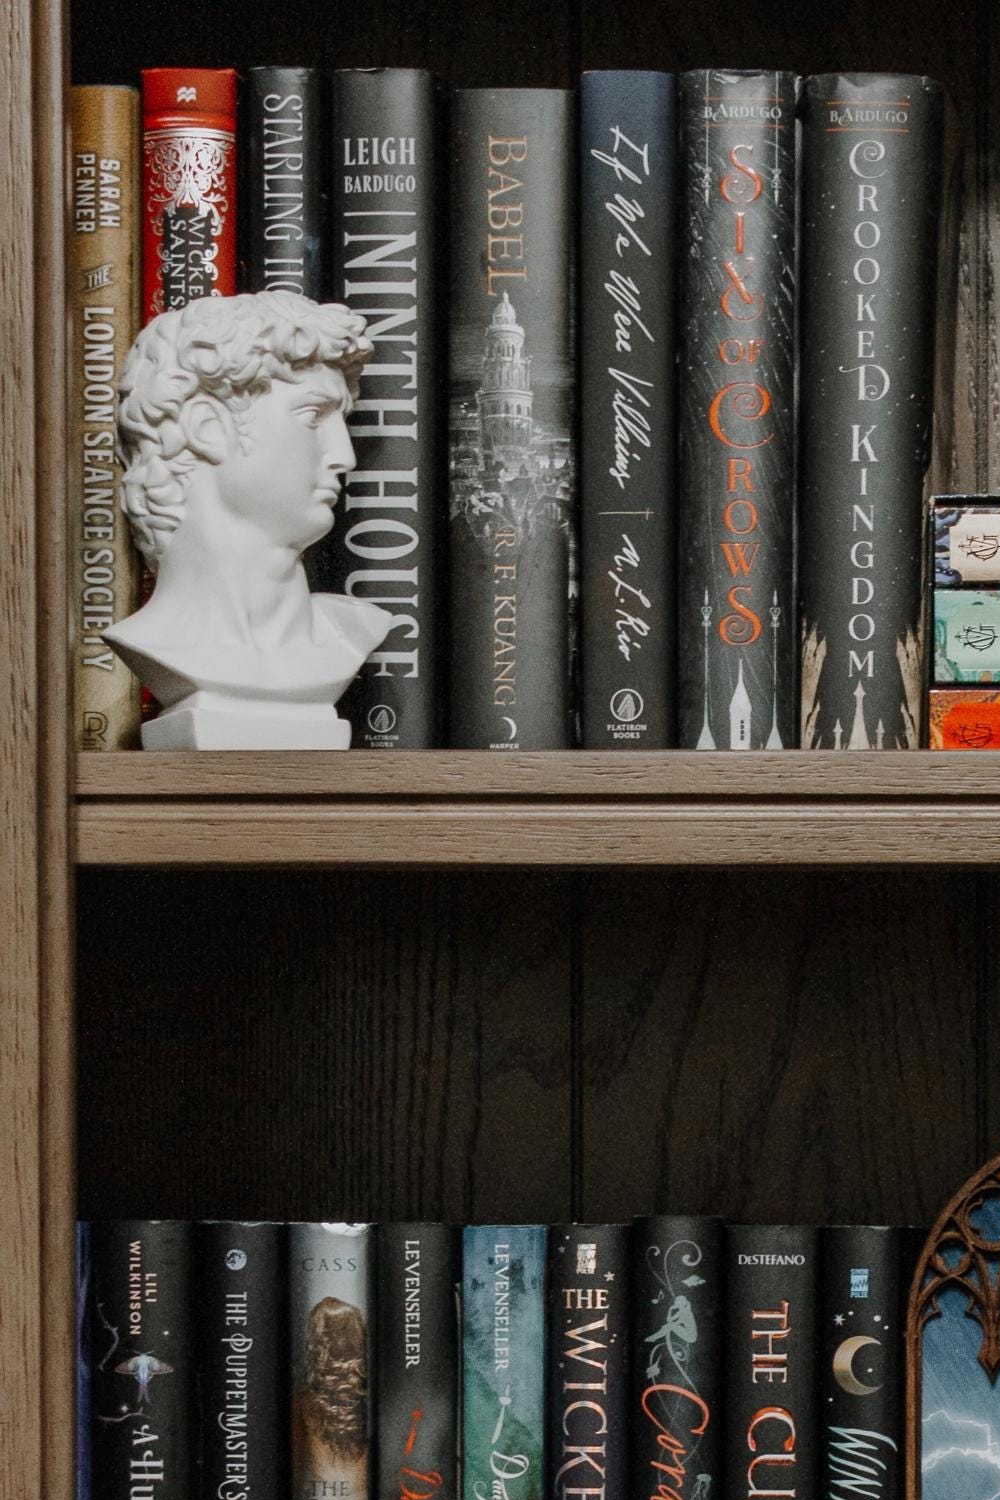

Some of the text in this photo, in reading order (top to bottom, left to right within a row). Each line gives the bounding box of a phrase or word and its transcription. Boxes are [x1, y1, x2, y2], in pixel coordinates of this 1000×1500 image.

[343, 137, 417, 166] LEIGH
[703, 103, 783, 123] BARDUGO
[828, 107, 909, 126] BARDUGO
[75, 153, 96, 233] PENNER
[99, 158, 121, 228] SARAH
[263, 93, 304, 241] STARLING
[343, 175, 417, 194] BARDUGO
[486, 134, 529, 296] BABEL
[168, 220, 185, 308] SAINTS
[600, 193, 656, 490] We Were Villains
[83, 306, 121, 541] LONDON SÉANCE
[838, 139, 892, 678] CROOKED KINGDOM
[707, 338, 776, 646] OF CROWS
[492, 592, 517, 707] KUANG
[606, 723, 648, 732] FLATIRON
[612, 732, 642, 740] BOOKS
[129, 1240, 142, 1336] WILKINSON
[144, 1272, 158, 1304] LILI
[302, 1257, 358, 1273] CASS
[405, 1239, 421, 1370] LEVENSELLER
[562, 1288, 610, 1310] THE
[226, 1291, 248, 1327] THE
[493, 1243, 511, 1372] LEVENSELLER
[752, 1299, 791, 1385] THE
[308, 1480, 350, 1497] THE
